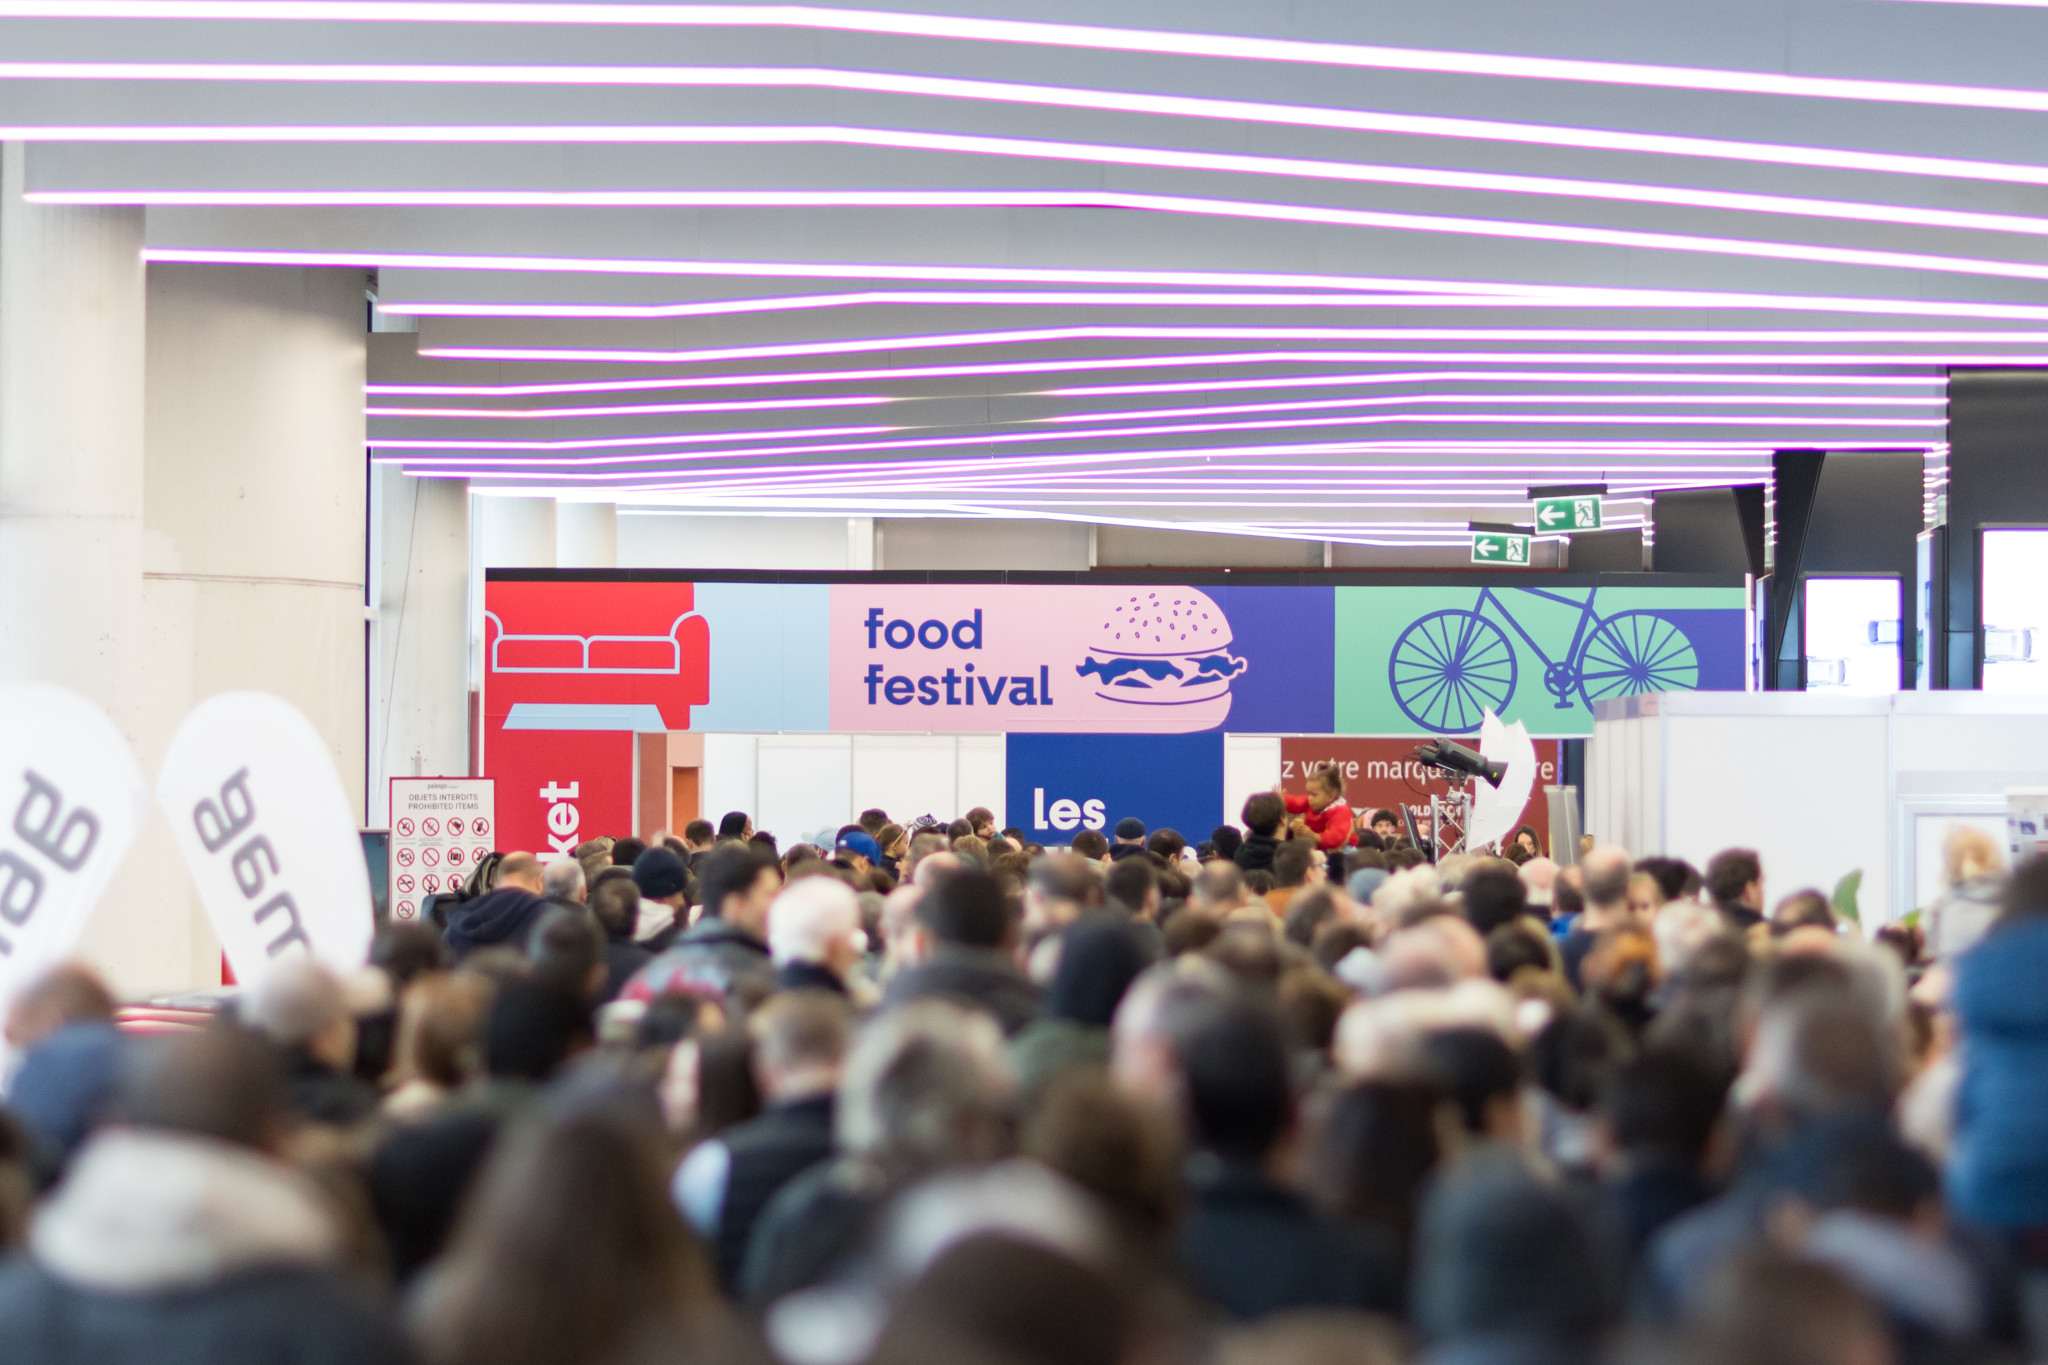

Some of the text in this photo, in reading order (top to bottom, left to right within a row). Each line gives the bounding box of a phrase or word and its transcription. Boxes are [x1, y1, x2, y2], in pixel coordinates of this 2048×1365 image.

[864, 608, 982, 649] food
[864, 663, 1053, 705] festival
[1367, 761, 1443, 785] marqu
[1034, 787, 1106, 830] les
